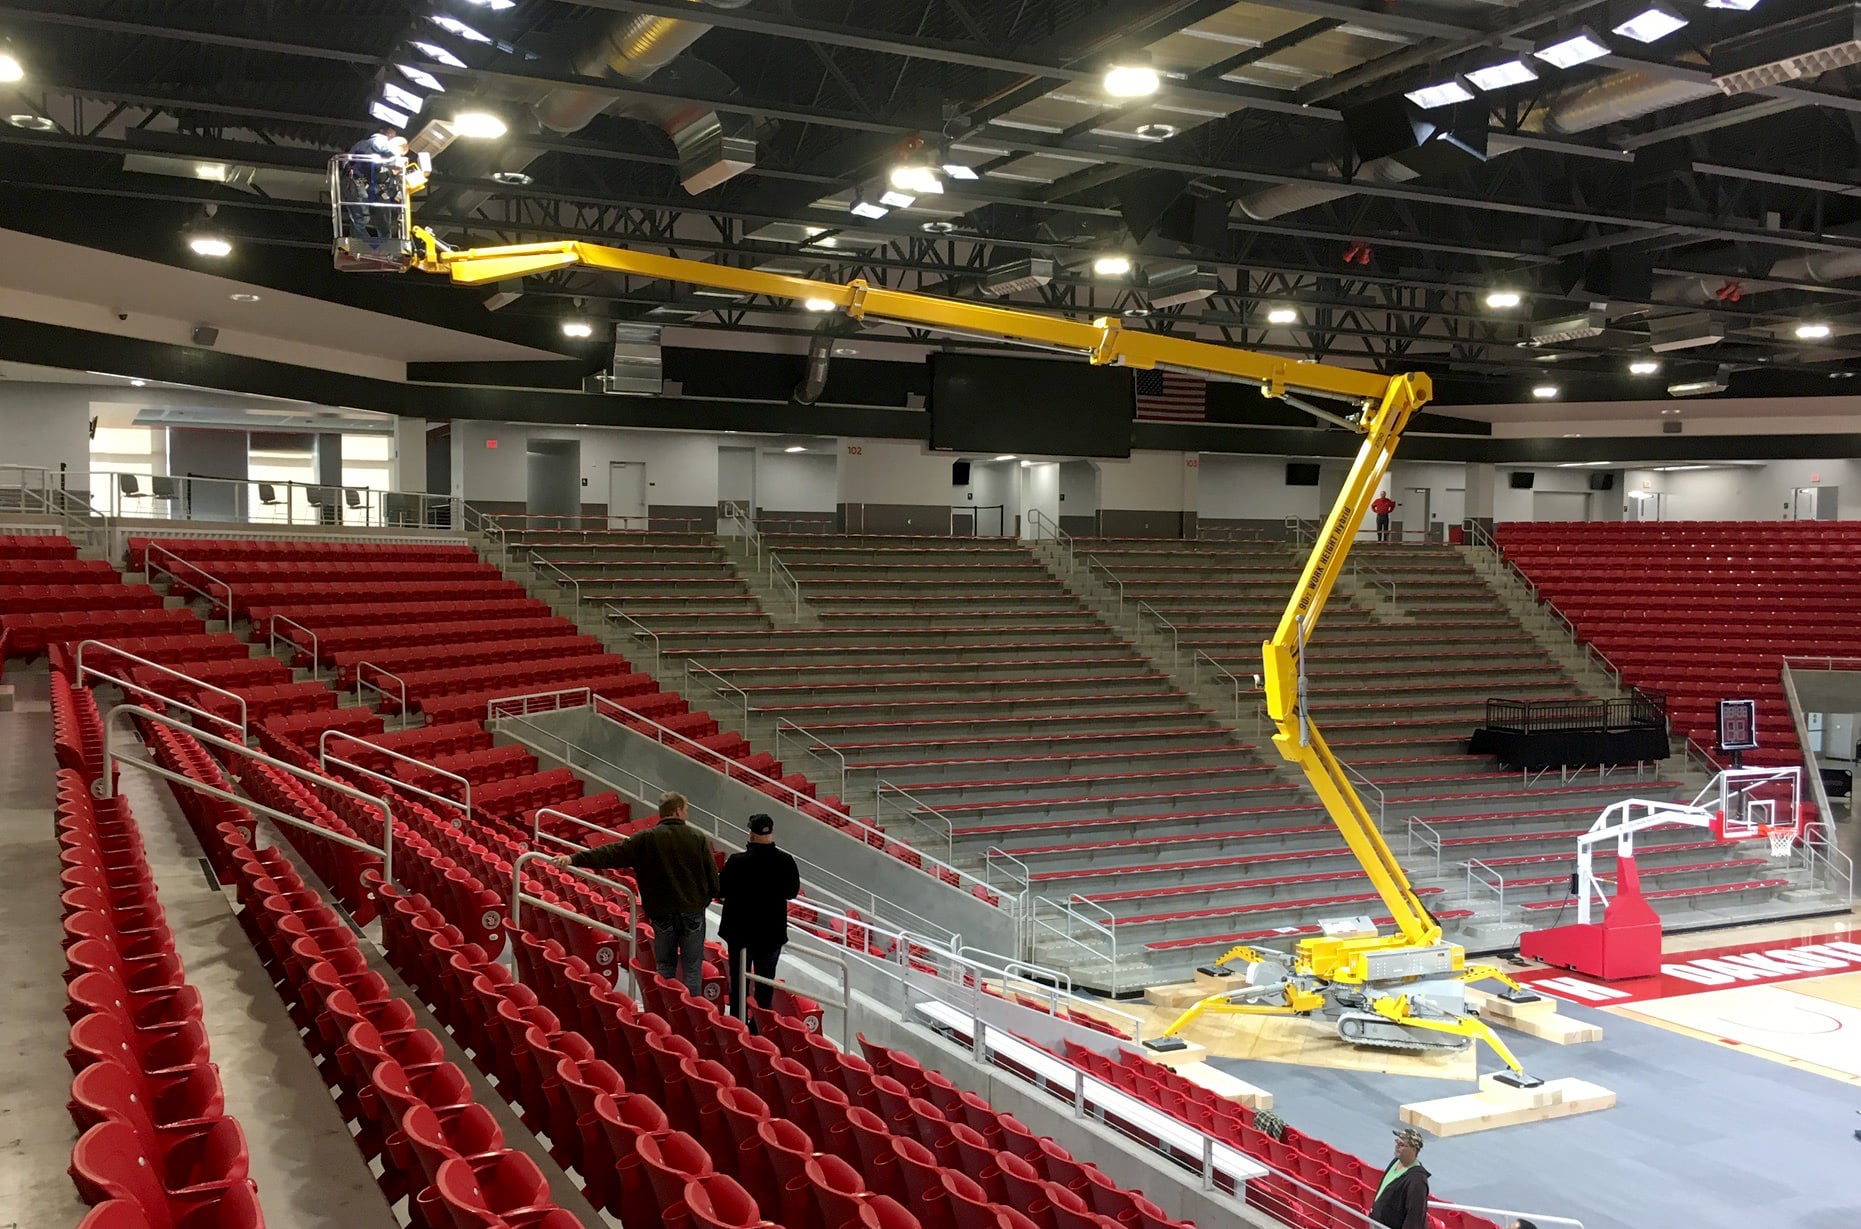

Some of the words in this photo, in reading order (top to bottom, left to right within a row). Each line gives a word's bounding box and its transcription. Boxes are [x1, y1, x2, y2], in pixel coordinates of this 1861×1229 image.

[847, 446, 862, 456] 102
[1307, 565, 1324, 590] WORK
[1319, 535, 1338, 564] HEIGHT
[1334, 506, 1351, 535] Hybrid
